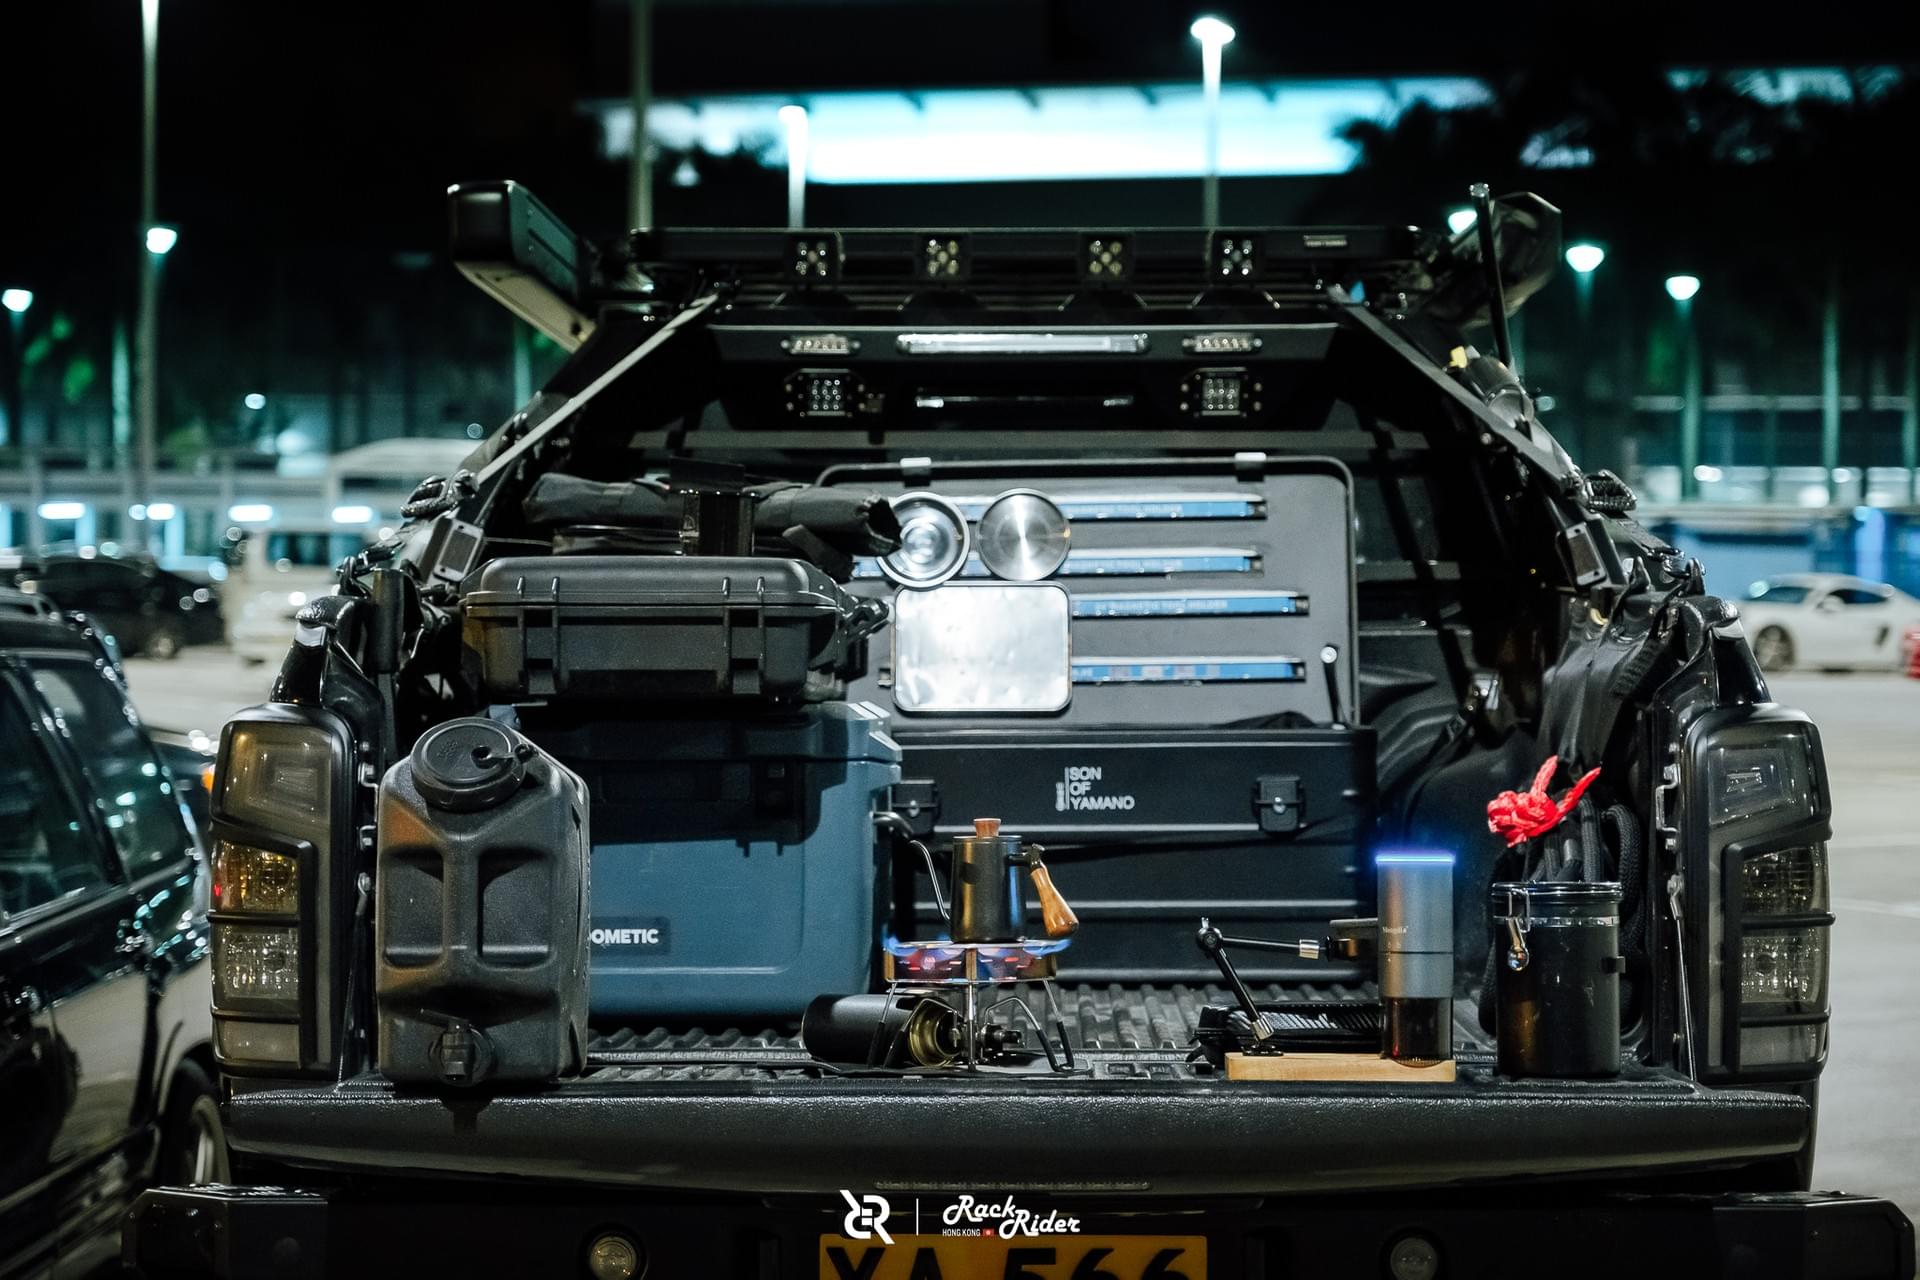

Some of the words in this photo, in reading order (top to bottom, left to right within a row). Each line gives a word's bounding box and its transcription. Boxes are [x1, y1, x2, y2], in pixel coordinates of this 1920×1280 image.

[1069, 766, 1102, 781] SON
[1069, 781, 1091, 796] OF
[1070, 795, 1135, 811] YAMANO
[587, 928, 659, 945] OMETIC
